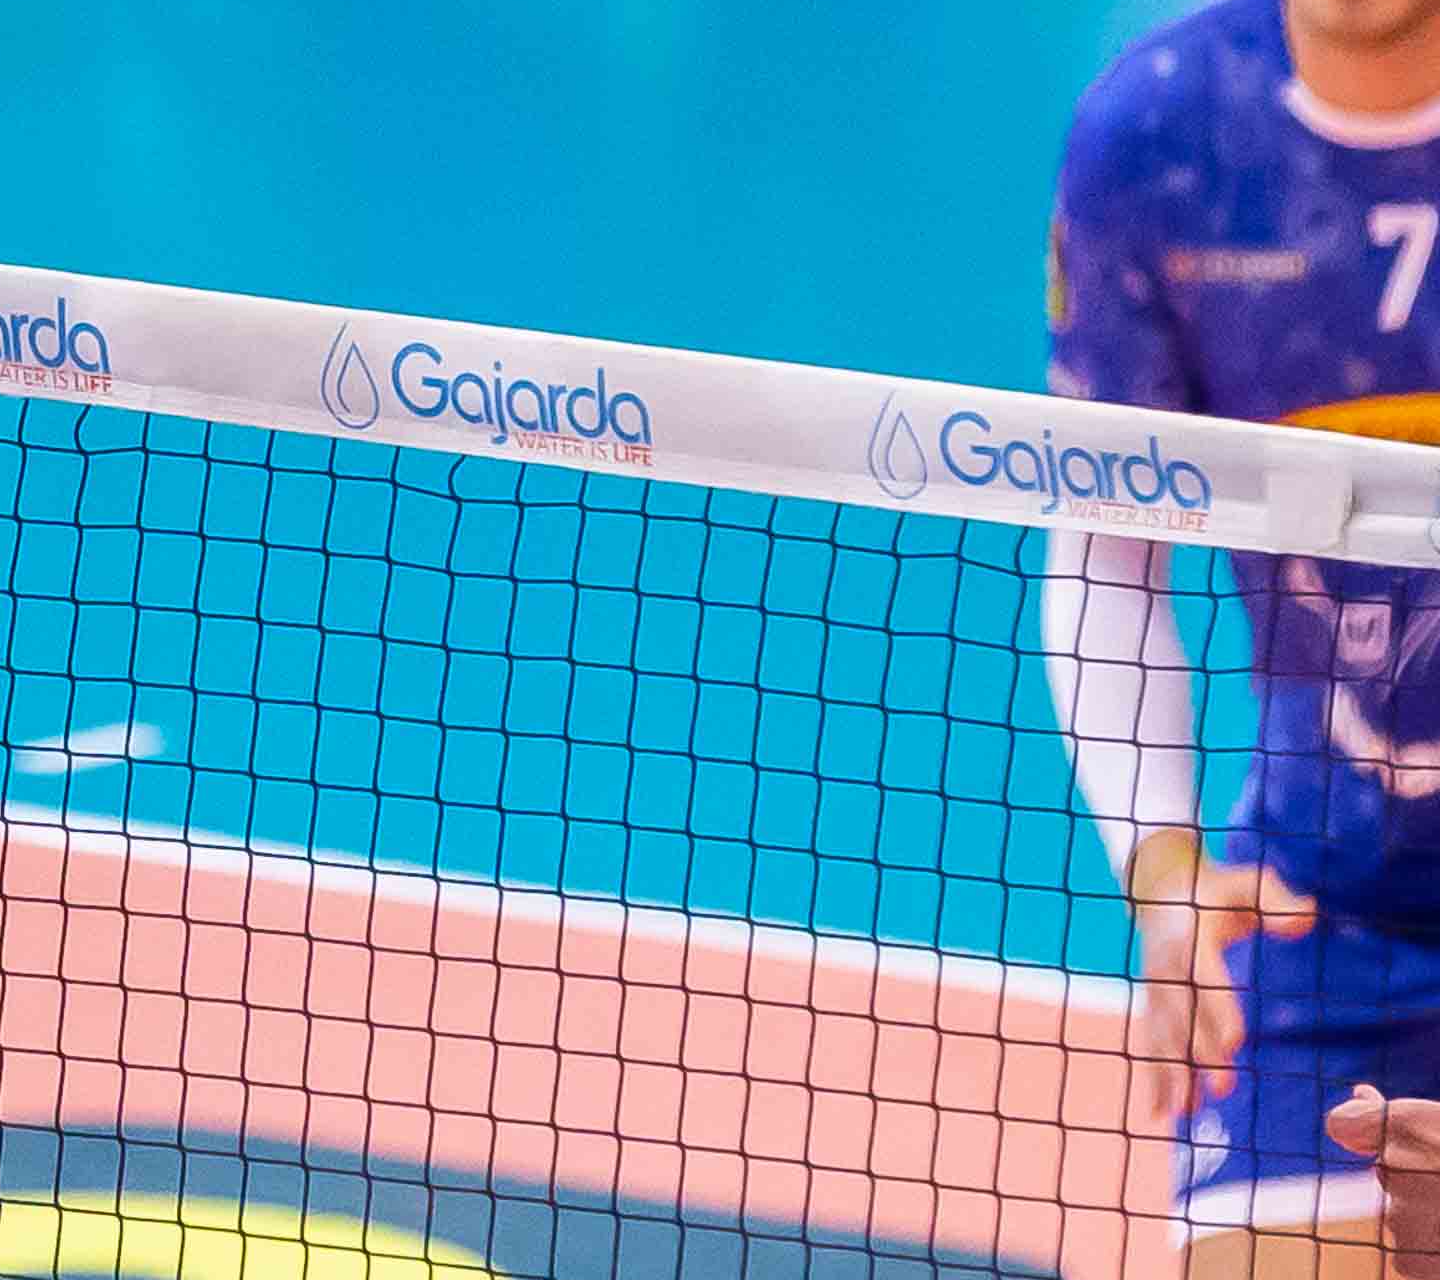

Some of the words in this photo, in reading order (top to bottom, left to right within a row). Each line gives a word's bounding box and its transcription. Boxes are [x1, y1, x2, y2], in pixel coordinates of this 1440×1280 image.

[1366, 204, 1439, 332] 7
[72, 372, 113, 395] LIFE
[392, 343, 652, 445] Gajarda
[512, 431, 585, 458] WATER
[613, 442, 653, 466] LIFE
[939, 410, 1211, 514] Gajarda
